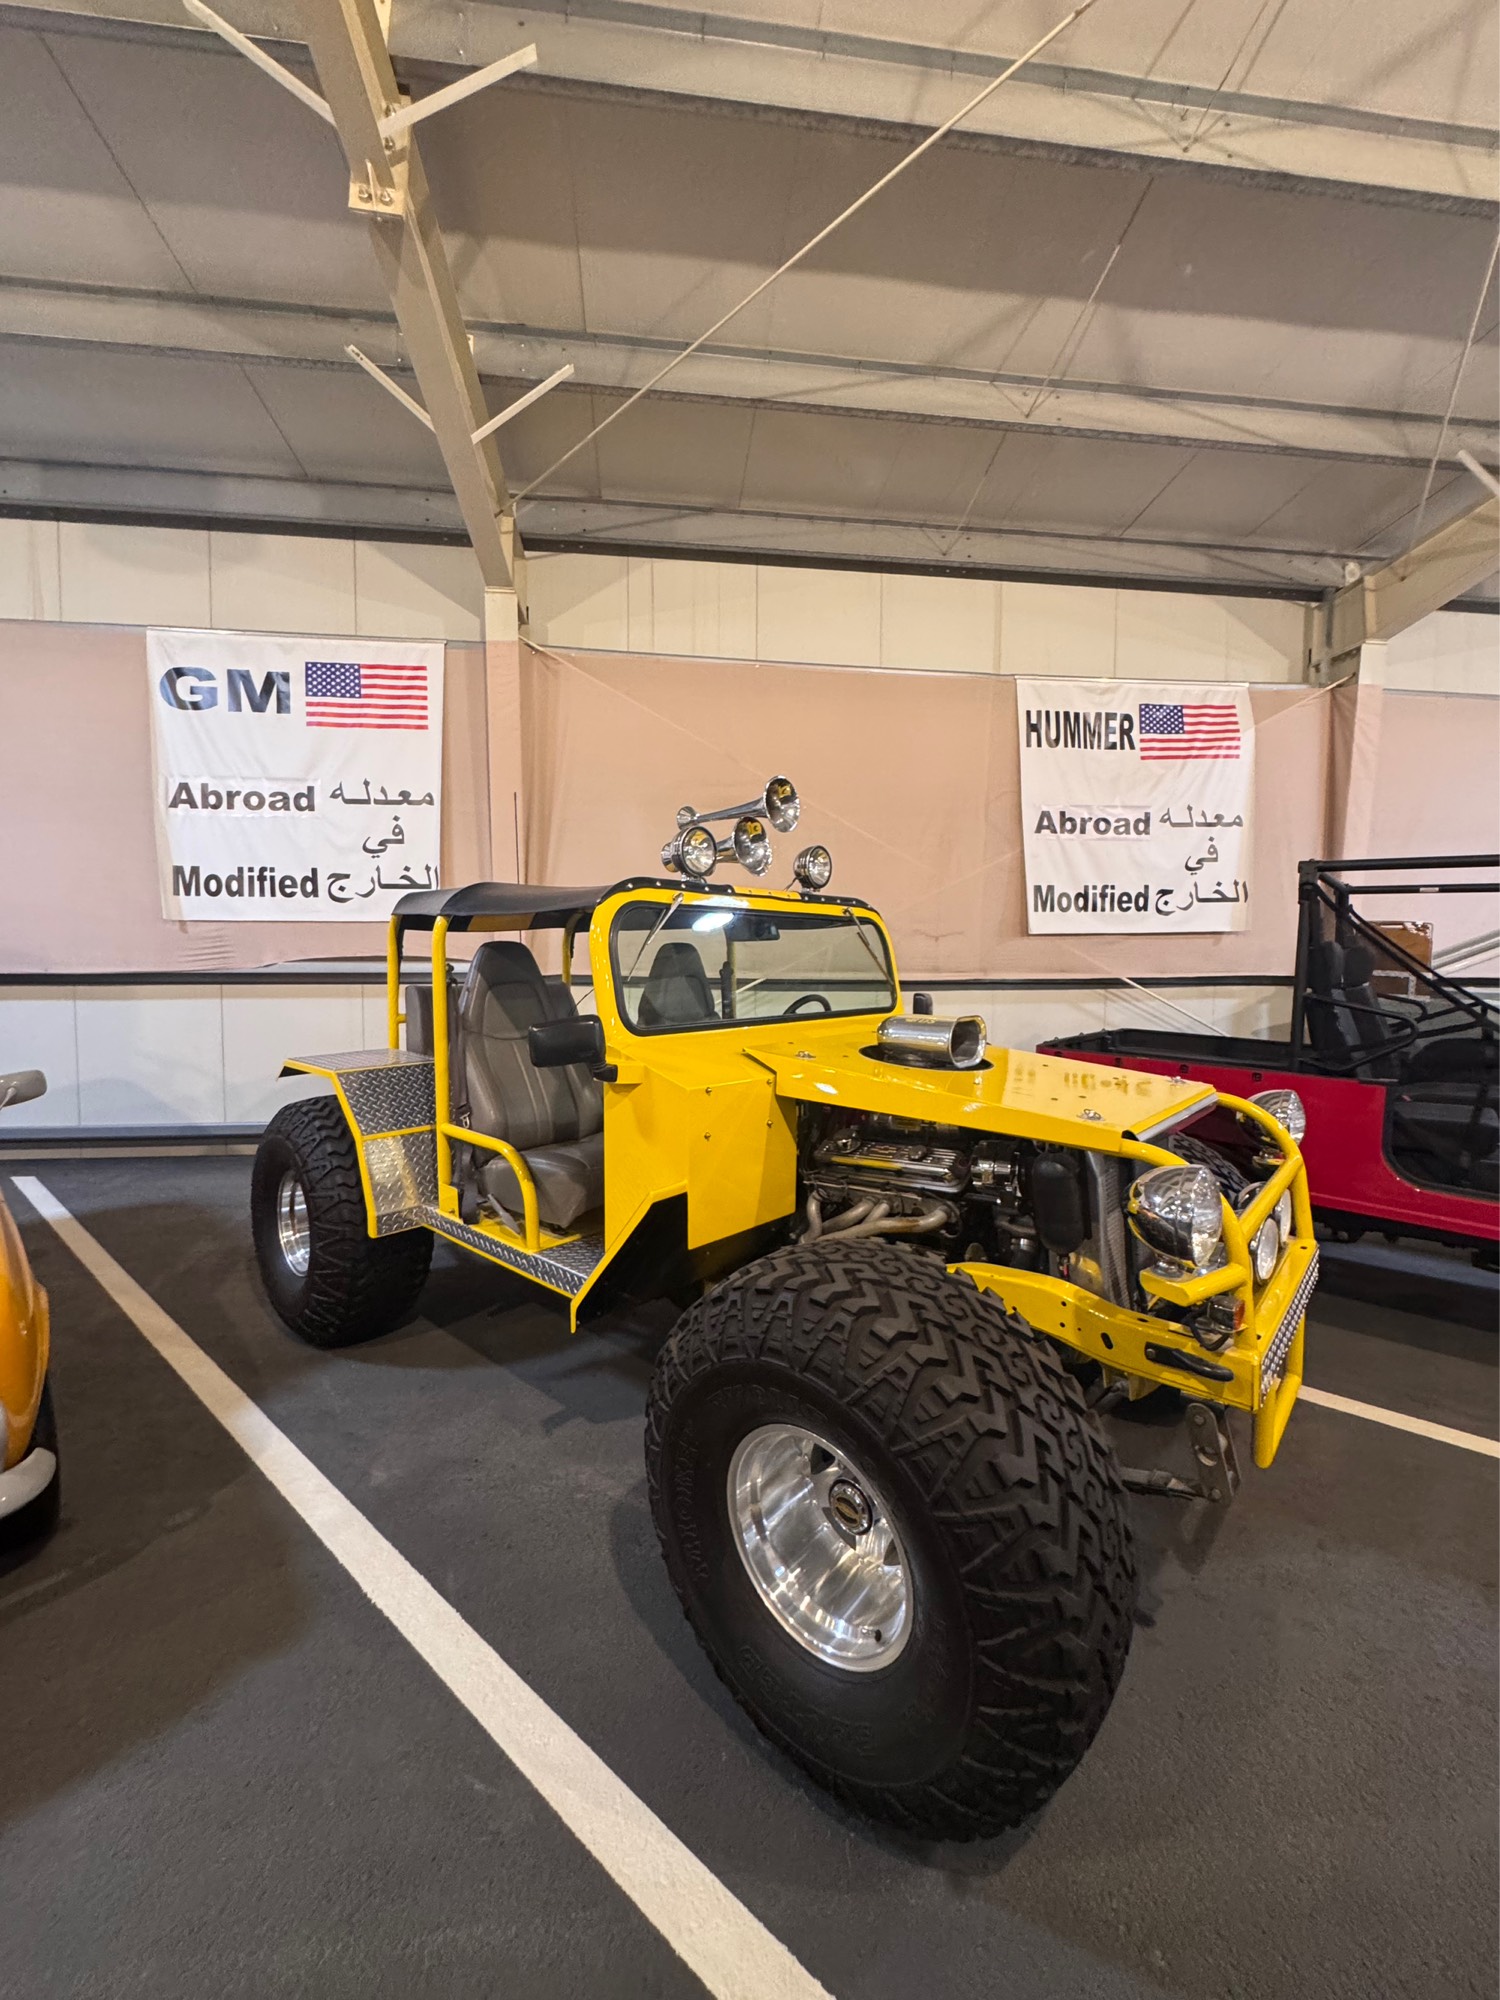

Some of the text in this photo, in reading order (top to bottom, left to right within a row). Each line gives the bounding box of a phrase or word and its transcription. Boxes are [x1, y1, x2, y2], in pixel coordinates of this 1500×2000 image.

[159, 666, 291, 714] GM
[1026, 710, 1136, 750] HUMMER
[168, 782, 315, 812] Abroad
[330, 778, 434, 806] معدله
[1034, 811, 1151, 835] Abroad
[1159, 804, 1243, 828] معدله
[362, 815, 405, 859] في
[1184, 836, 1219, 876] في
[172, 865, 319, 898] Modified
[327, 864, 439, 903] الخارج
[1033, 885, 1149, 913] Modified
[1155, 879, 1249, 916] الخارج
